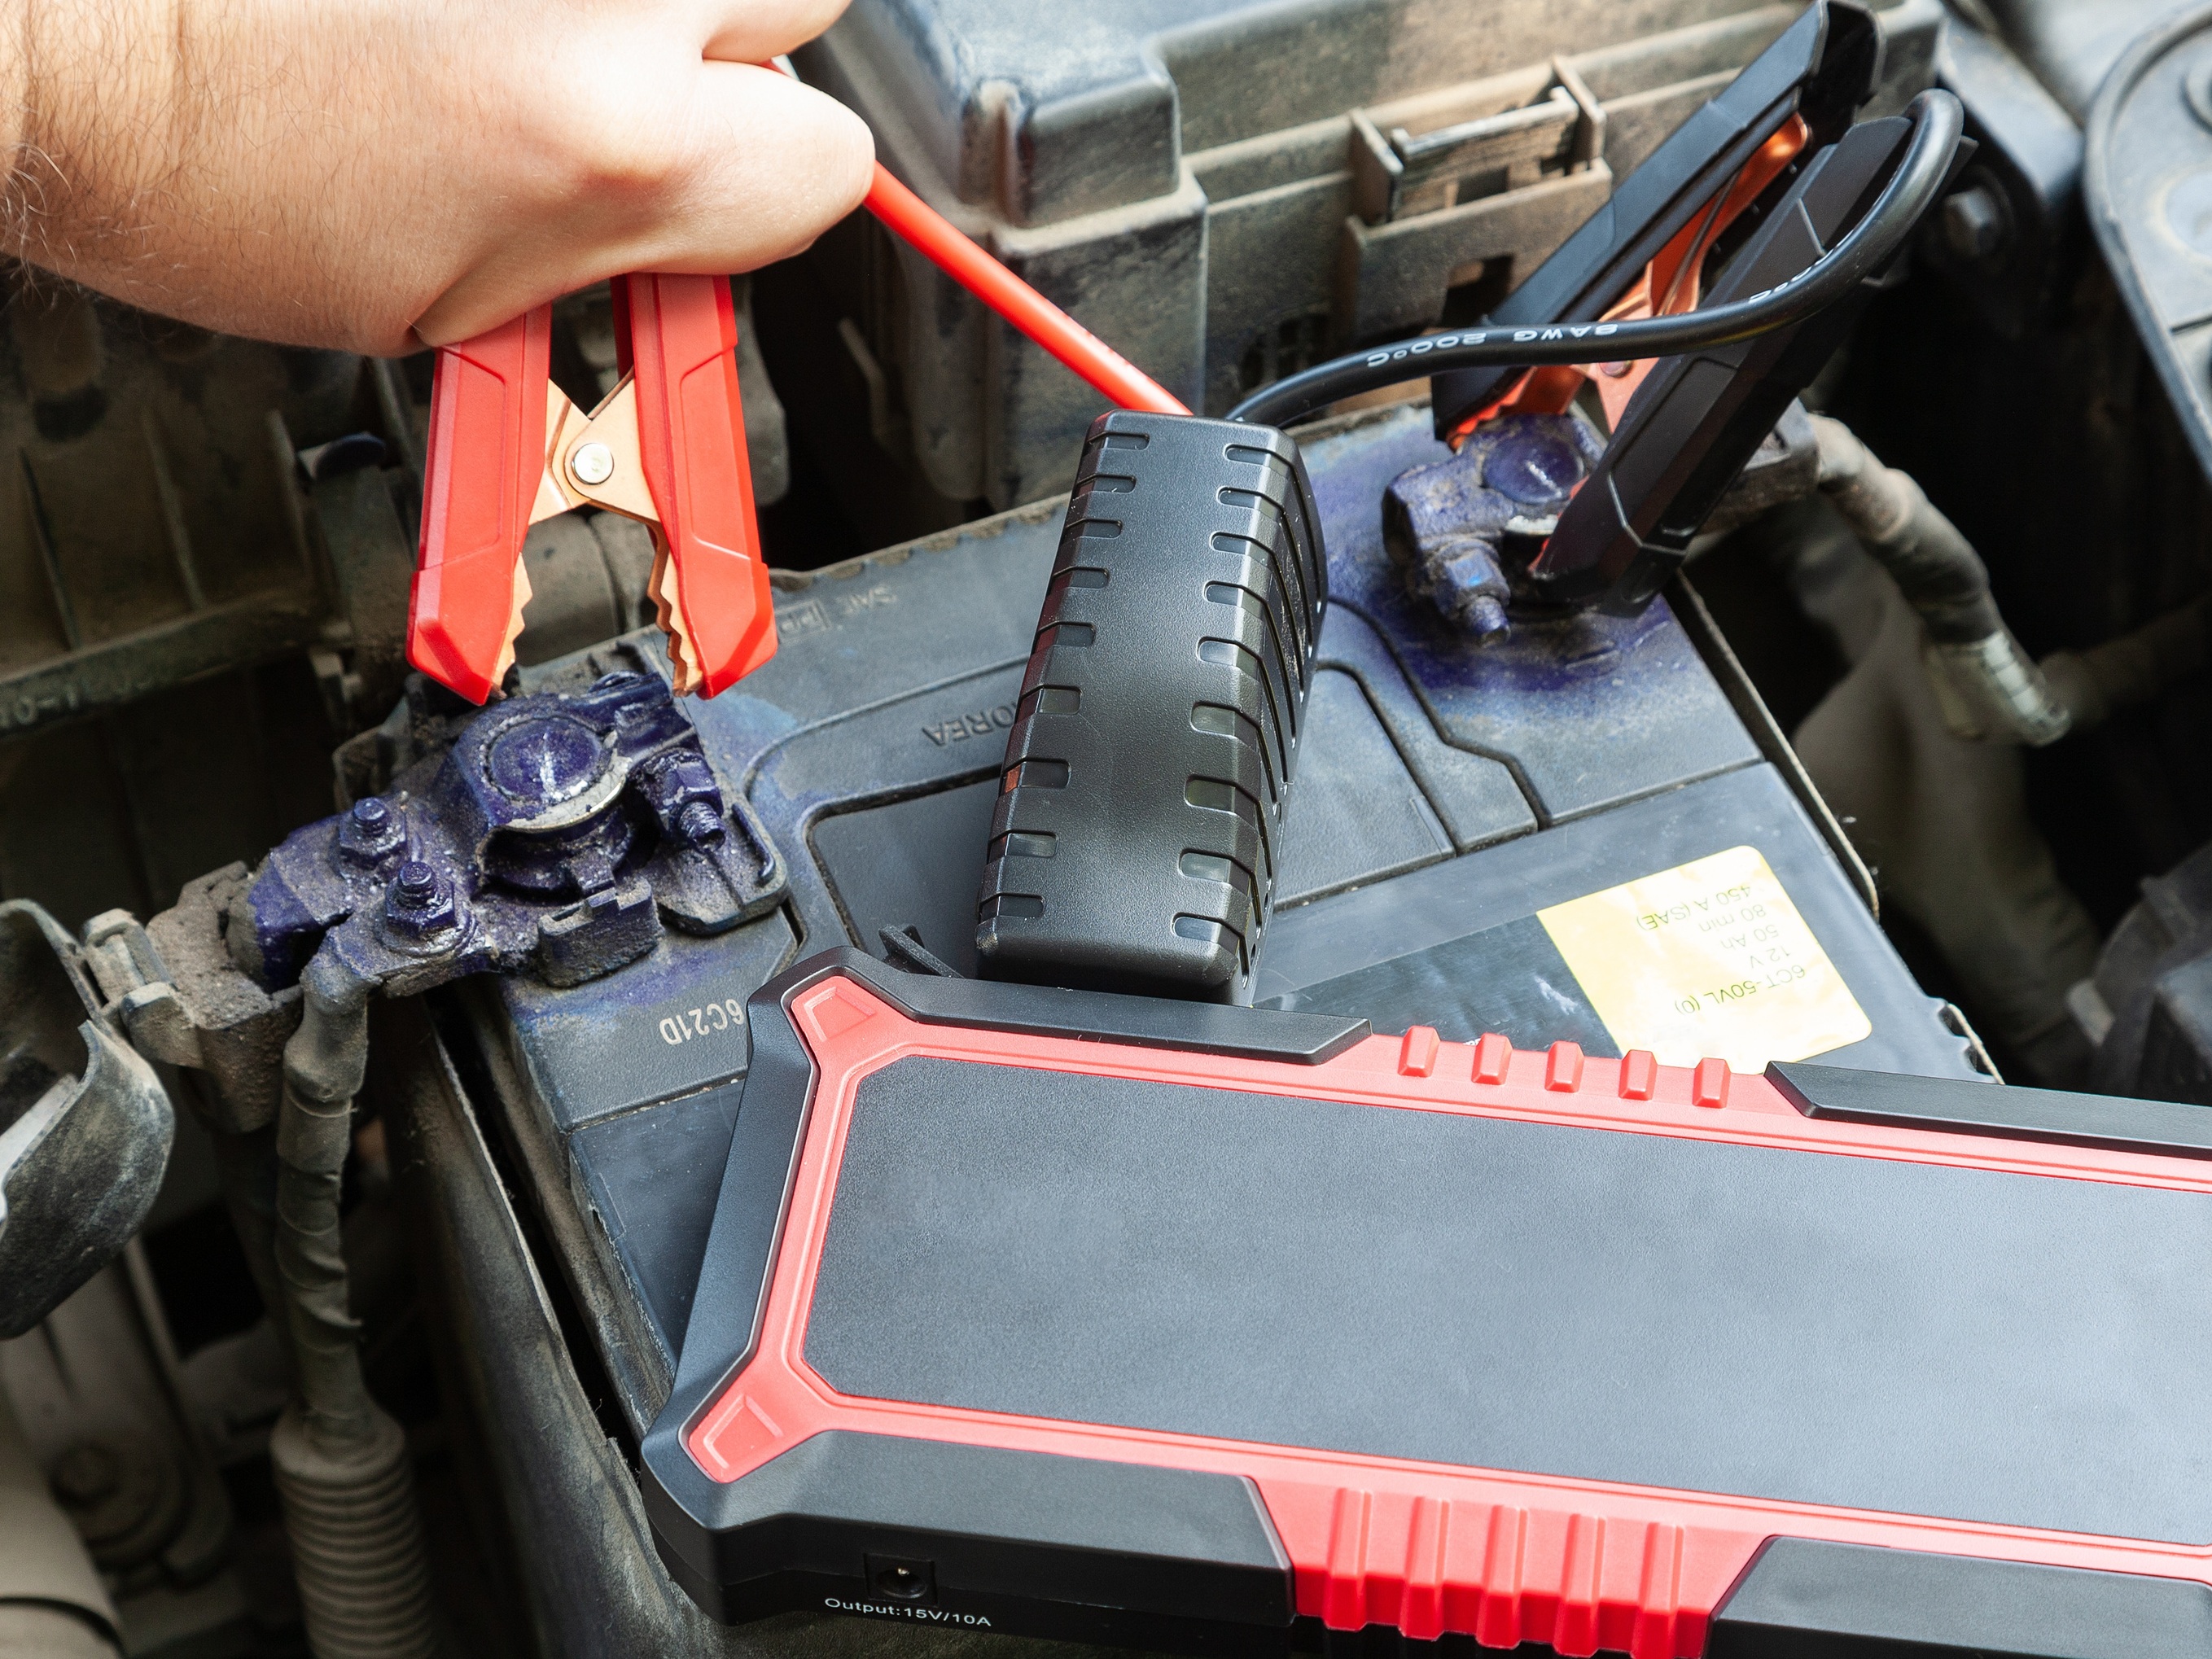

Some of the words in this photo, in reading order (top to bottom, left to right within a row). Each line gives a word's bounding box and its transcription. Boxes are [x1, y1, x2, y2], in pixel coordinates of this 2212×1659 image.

[1512, 323, 1619, 342] 8AWG
[1367, 332, 1487, 367] 200°C
[922, 701, 1017, 746] OREA
[1693, 897, 1709, 912] A
[1715, 885, 1751, 905] 450
[1636, 901, 1691, 930] (SAE)
[1740, 904, 1767, 921] 80
[1698, 913, 1735, 932] min
[1720, 934, 1746, 950] Ah
[1753, 924, 1780, 942] 50
[1750, 955, 1765, 969] V
[1766, 945, 1791, 962] 12
[1703, 964, 1806, 1005] 6CT-50VL
[659, 998, 745, 1045] 6C21D
[824, 1597, 992, 1627] Output:15V/10A
